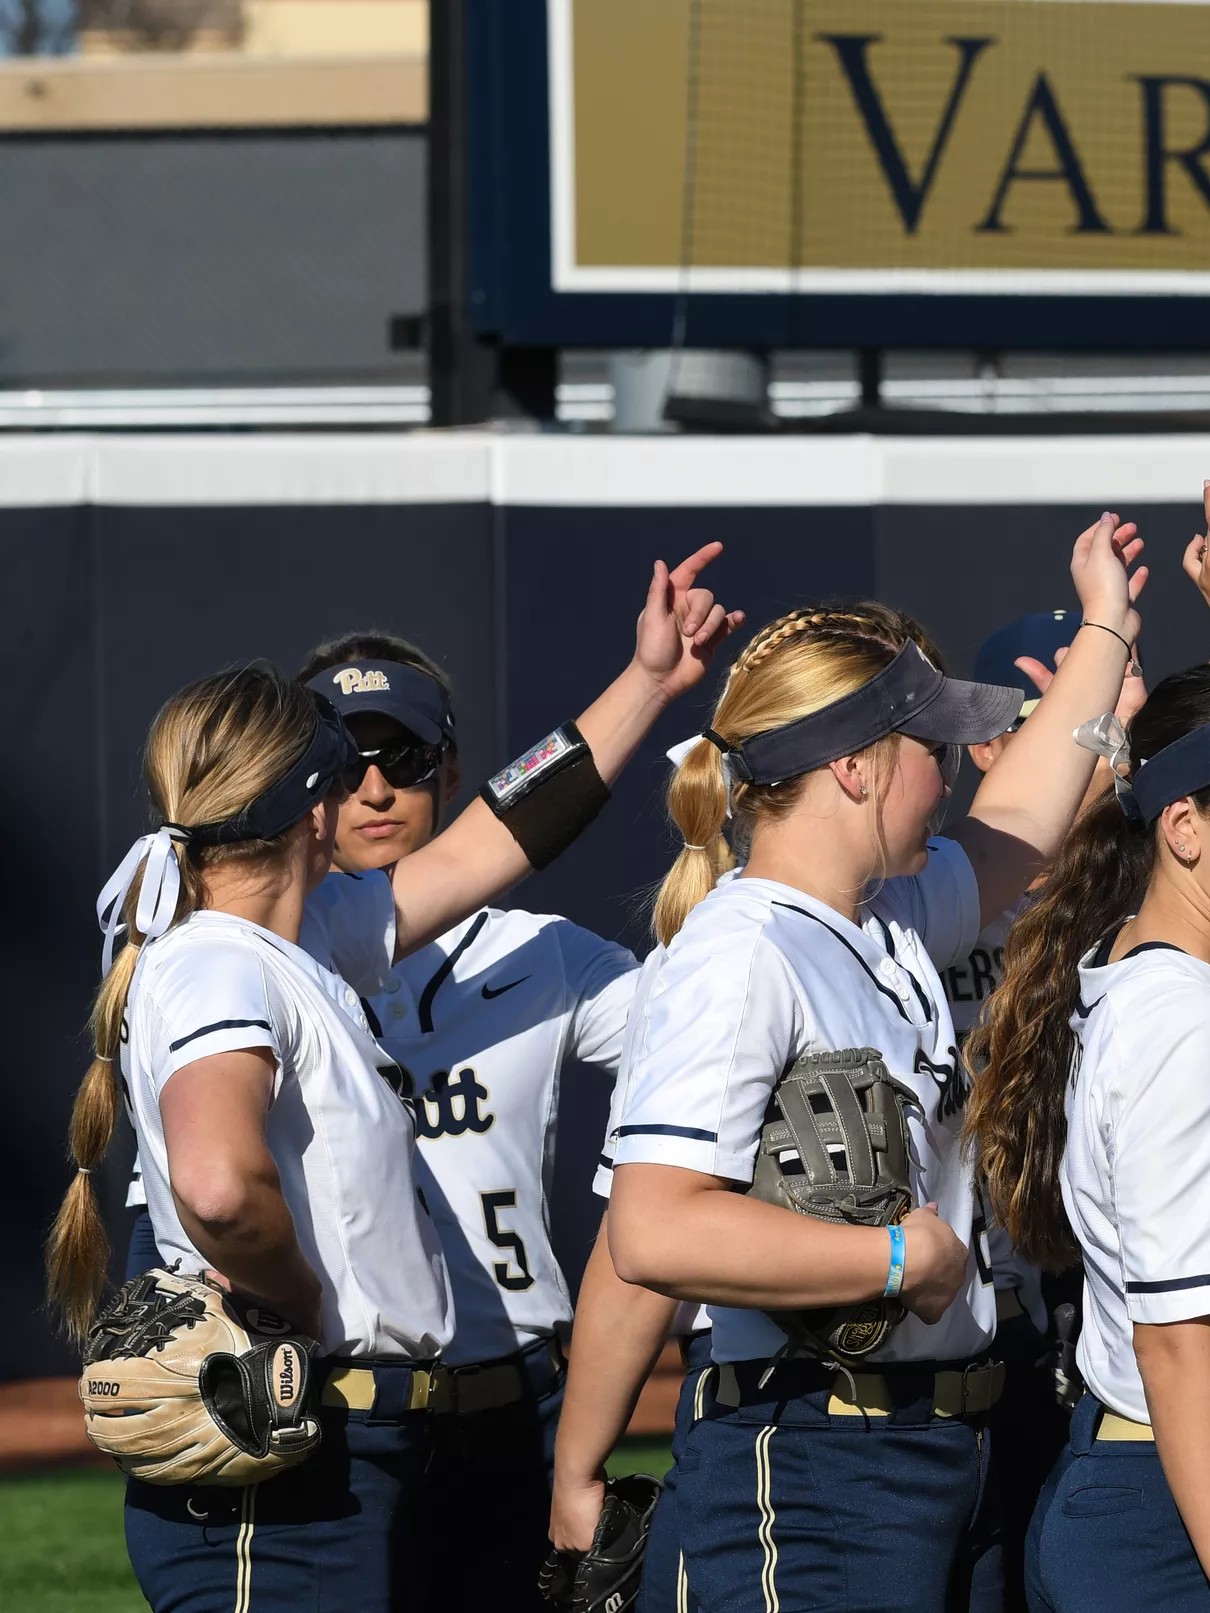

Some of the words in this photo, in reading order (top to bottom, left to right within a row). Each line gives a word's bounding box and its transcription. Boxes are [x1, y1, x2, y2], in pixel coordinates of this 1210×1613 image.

[332, 667, 391, 695] Pitt
[478, 1188, 536, 1293] 5
[280, 1347, 296, 1402] Wilson
